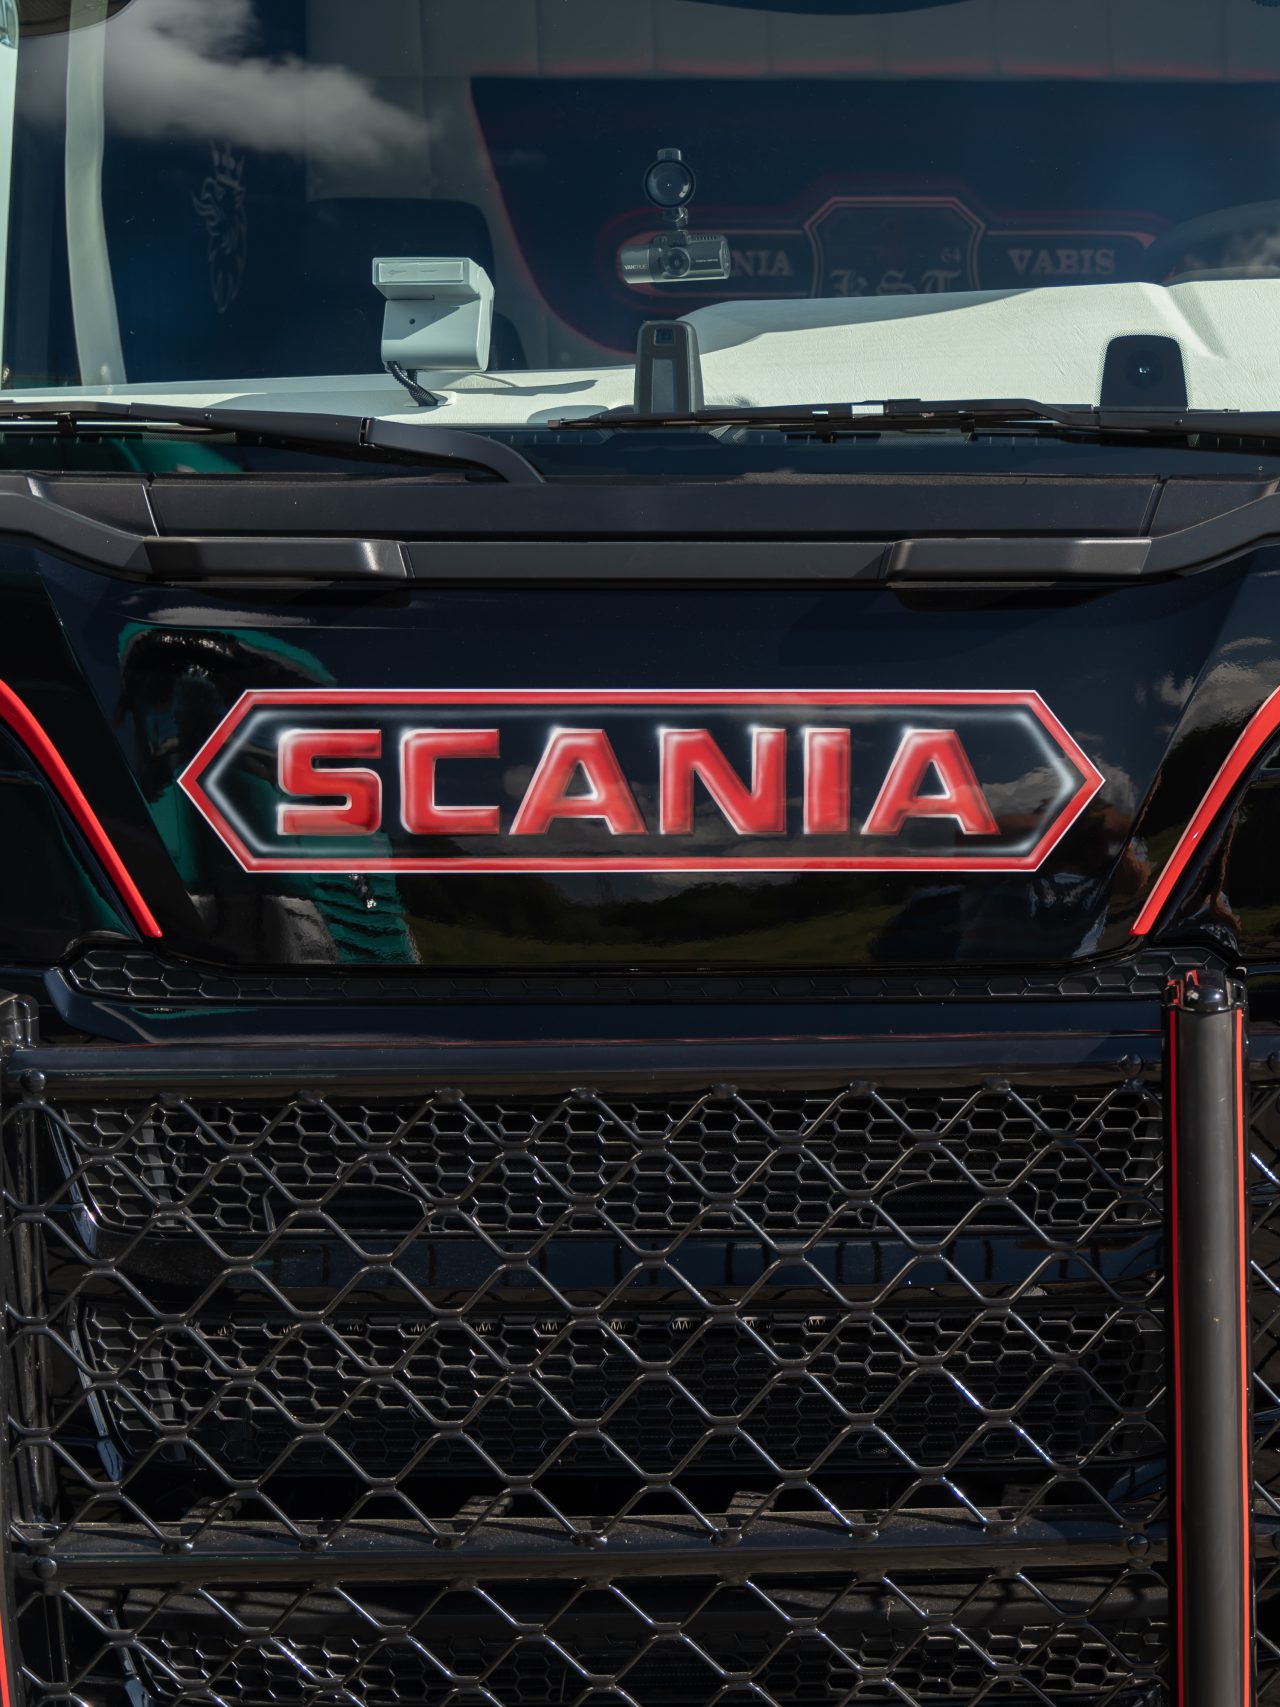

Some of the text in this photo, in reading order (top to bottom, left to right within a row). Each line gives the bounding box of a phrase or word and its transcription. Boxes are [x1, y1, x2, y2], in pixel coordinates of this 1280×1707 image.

[731, 249, 794, 276] NIA
[1007, 247, 1116, 275] VABIS
[276, 726, 1000, 836] SCANIA
